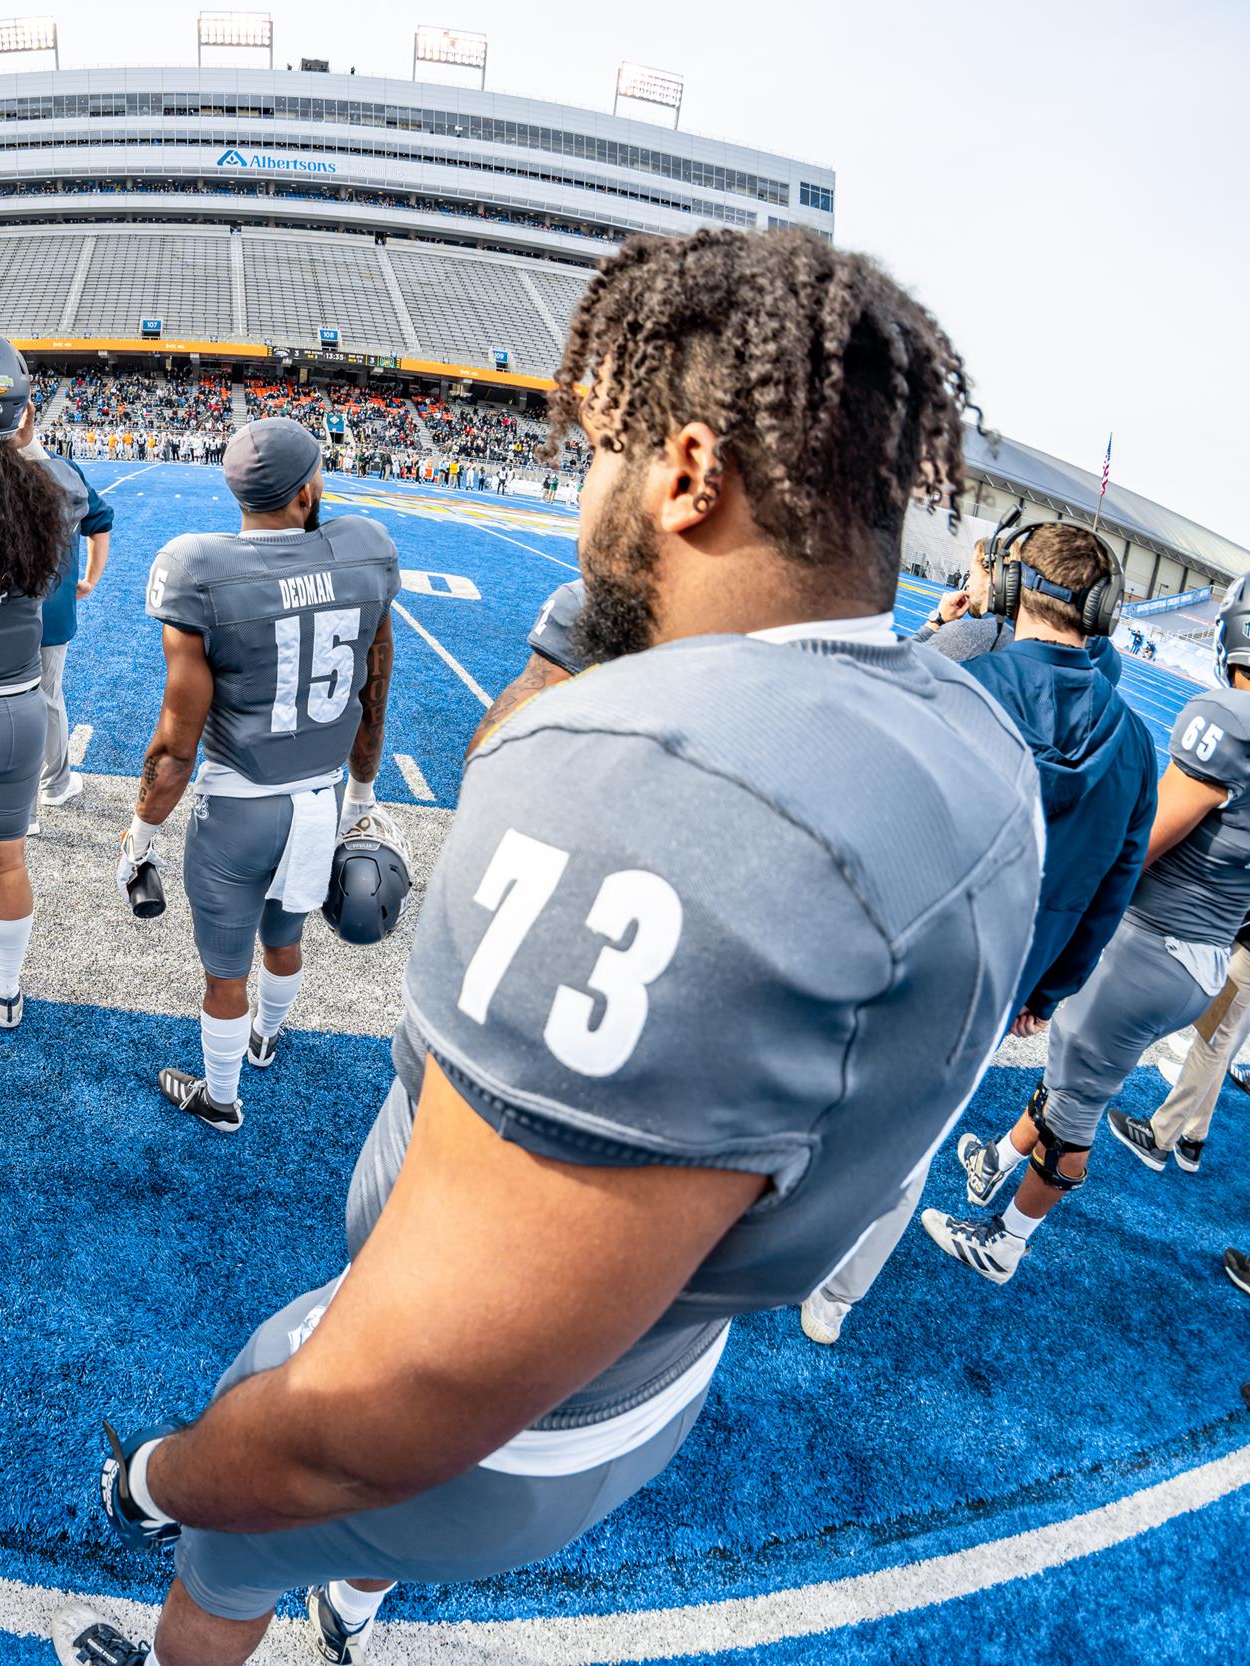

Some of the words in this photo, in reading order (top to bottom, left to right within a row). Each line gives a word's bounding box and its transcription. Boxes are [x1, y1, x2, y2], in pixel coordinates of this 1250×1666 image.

[250, 155, 337, 173] Albertsons
[325, 353, 344, 361] 13:35
[278, 571, 336, 610] DEDMAN
[270, 607, 362, 733] 15
[1181, 715, 1225, 762] 65
[457, 828, 683, 1078] 73
